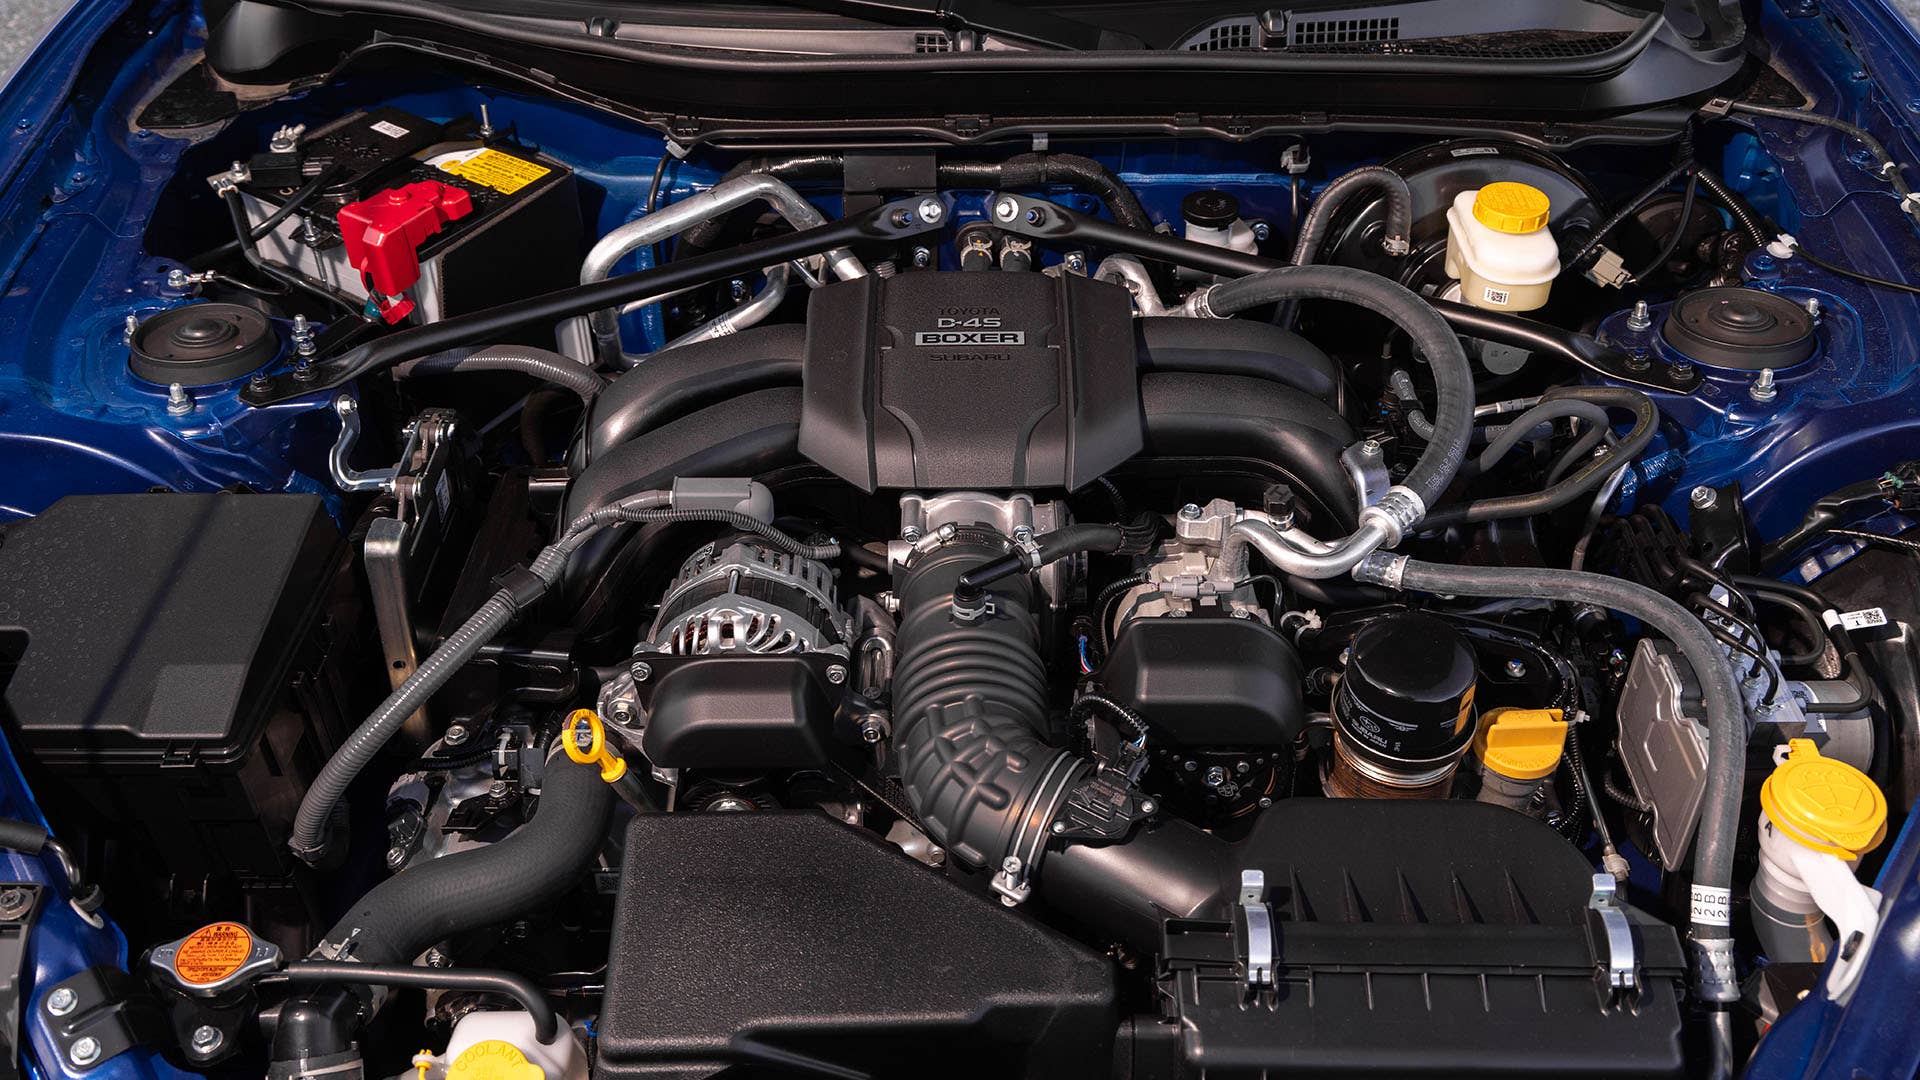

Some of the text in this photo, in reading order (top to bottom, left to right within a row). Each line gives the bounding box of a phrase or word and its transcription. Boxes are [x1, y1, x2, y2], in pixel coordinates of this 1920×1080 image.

[938, 306, 1000, 316] TOYOTA
[922, 333, 1019, 344] BOXER
[930, 353, 1011, 361] SUBARU
[456, 1044, 524, 1071] COOLANT
